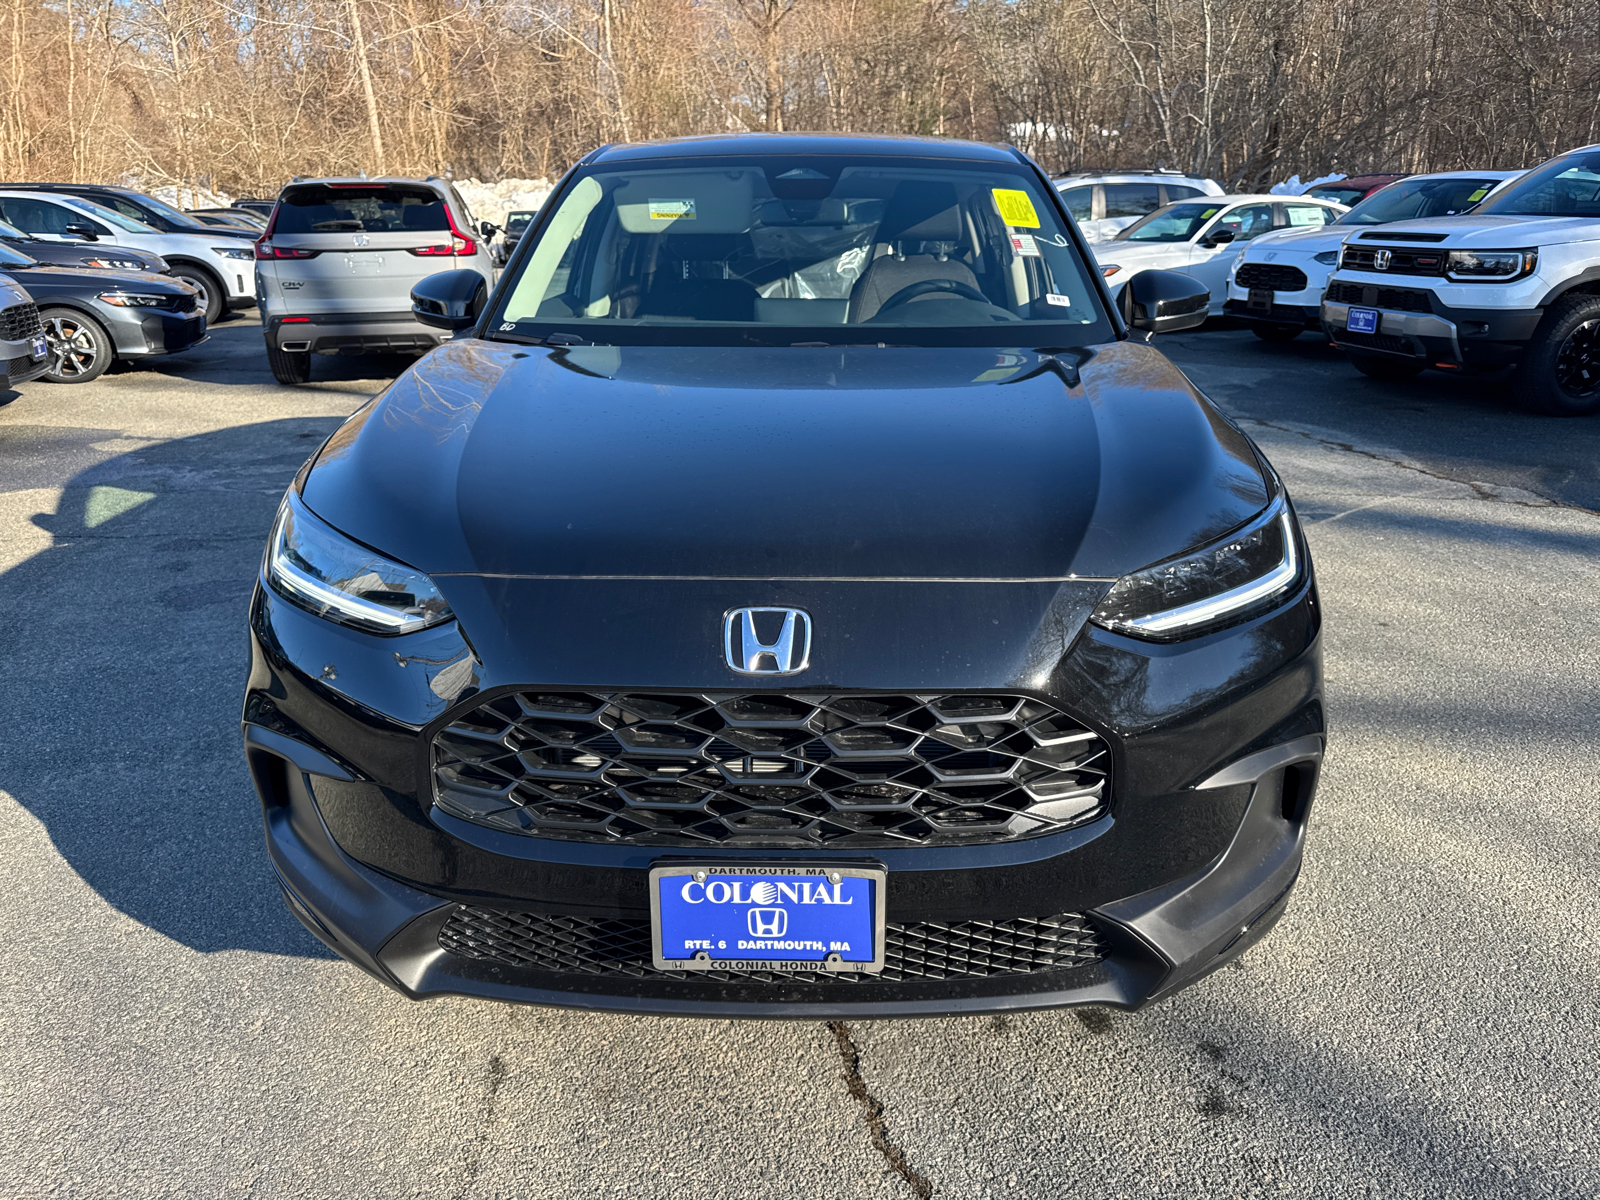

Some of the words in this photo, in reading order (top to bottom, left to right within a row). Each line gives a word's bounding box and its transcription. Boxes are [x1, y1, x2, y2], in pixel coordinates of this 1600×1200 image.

[806, 868, 827, 876] MA
[681, 881, 853, 905] COLONIAL
[684, 940, 715, 949] RTE.
[718, 940, 727, 949] 6
[737, 941, 827, 952] DARTMOUTH,
[830, 941, 851, 951] MA
[710, 961, 777, 970] COLONIAL
[780, 962, 827, 971] HONDA
